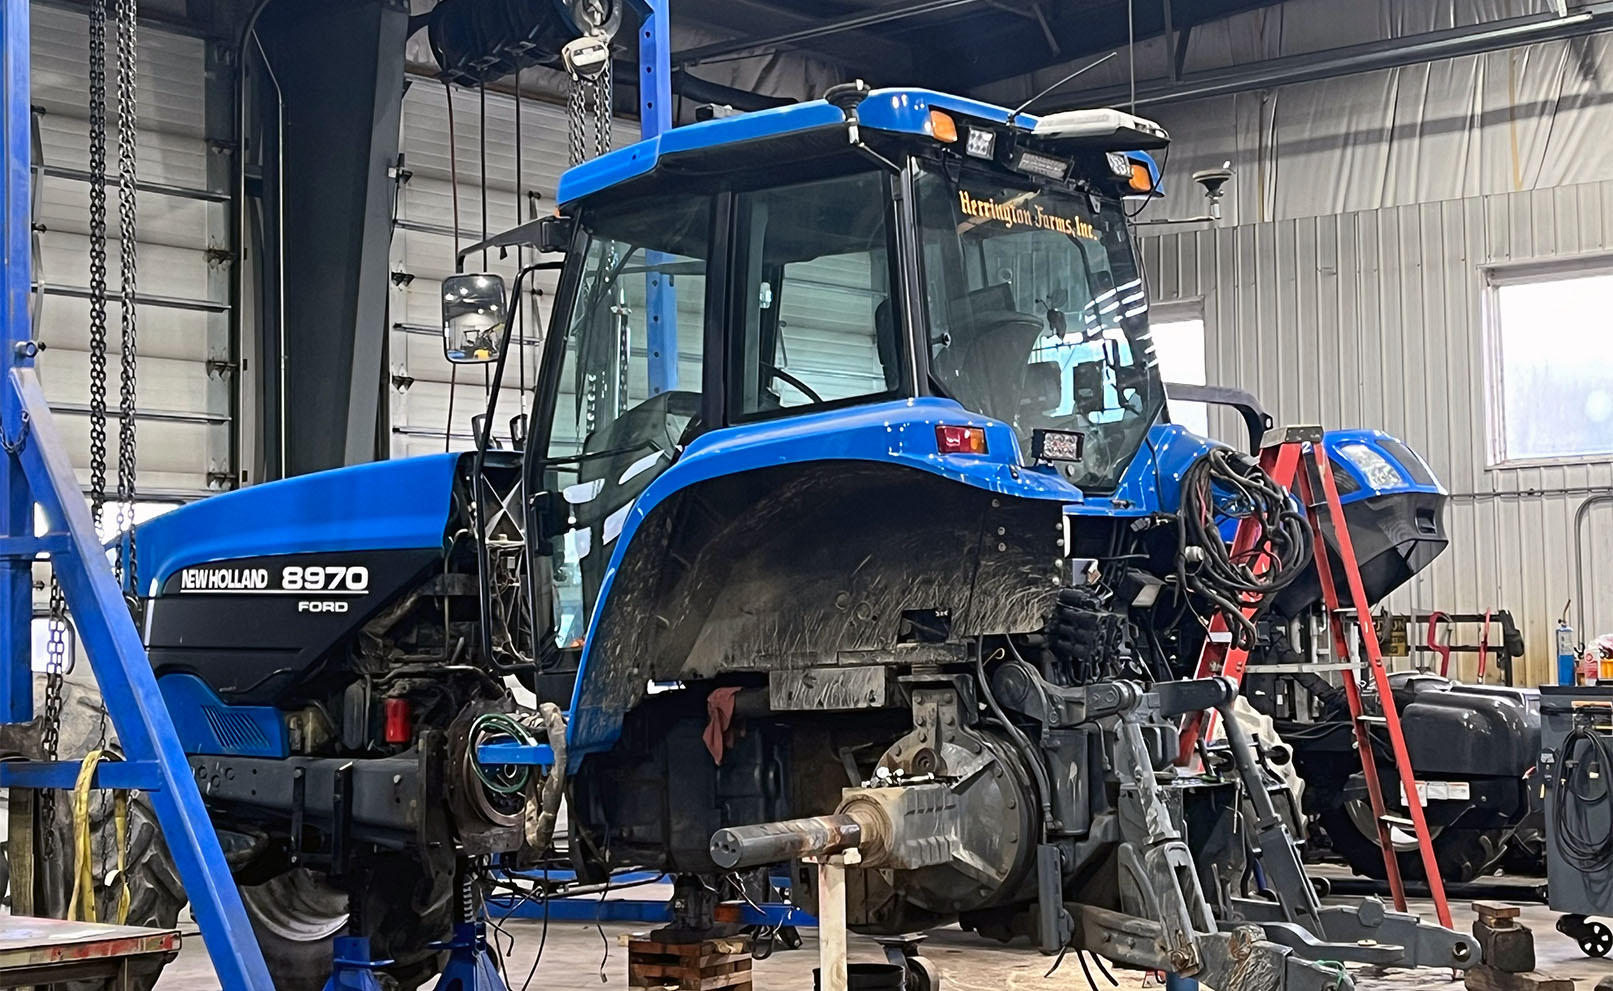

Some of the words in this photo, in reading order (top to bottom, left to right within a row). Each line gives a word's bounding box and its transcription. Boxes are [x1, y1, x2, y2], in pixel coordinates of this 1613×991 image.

[958, 190, 1033, 228] Herrington
[1034, 205, 1076, 237] Farms,
[1075, 215, 1098, 240] Inc.
[208, 569, 268, 589] HOLLAND
[282, 566, 369, 590] 8970
[298, 601, 349, 613] FORD
